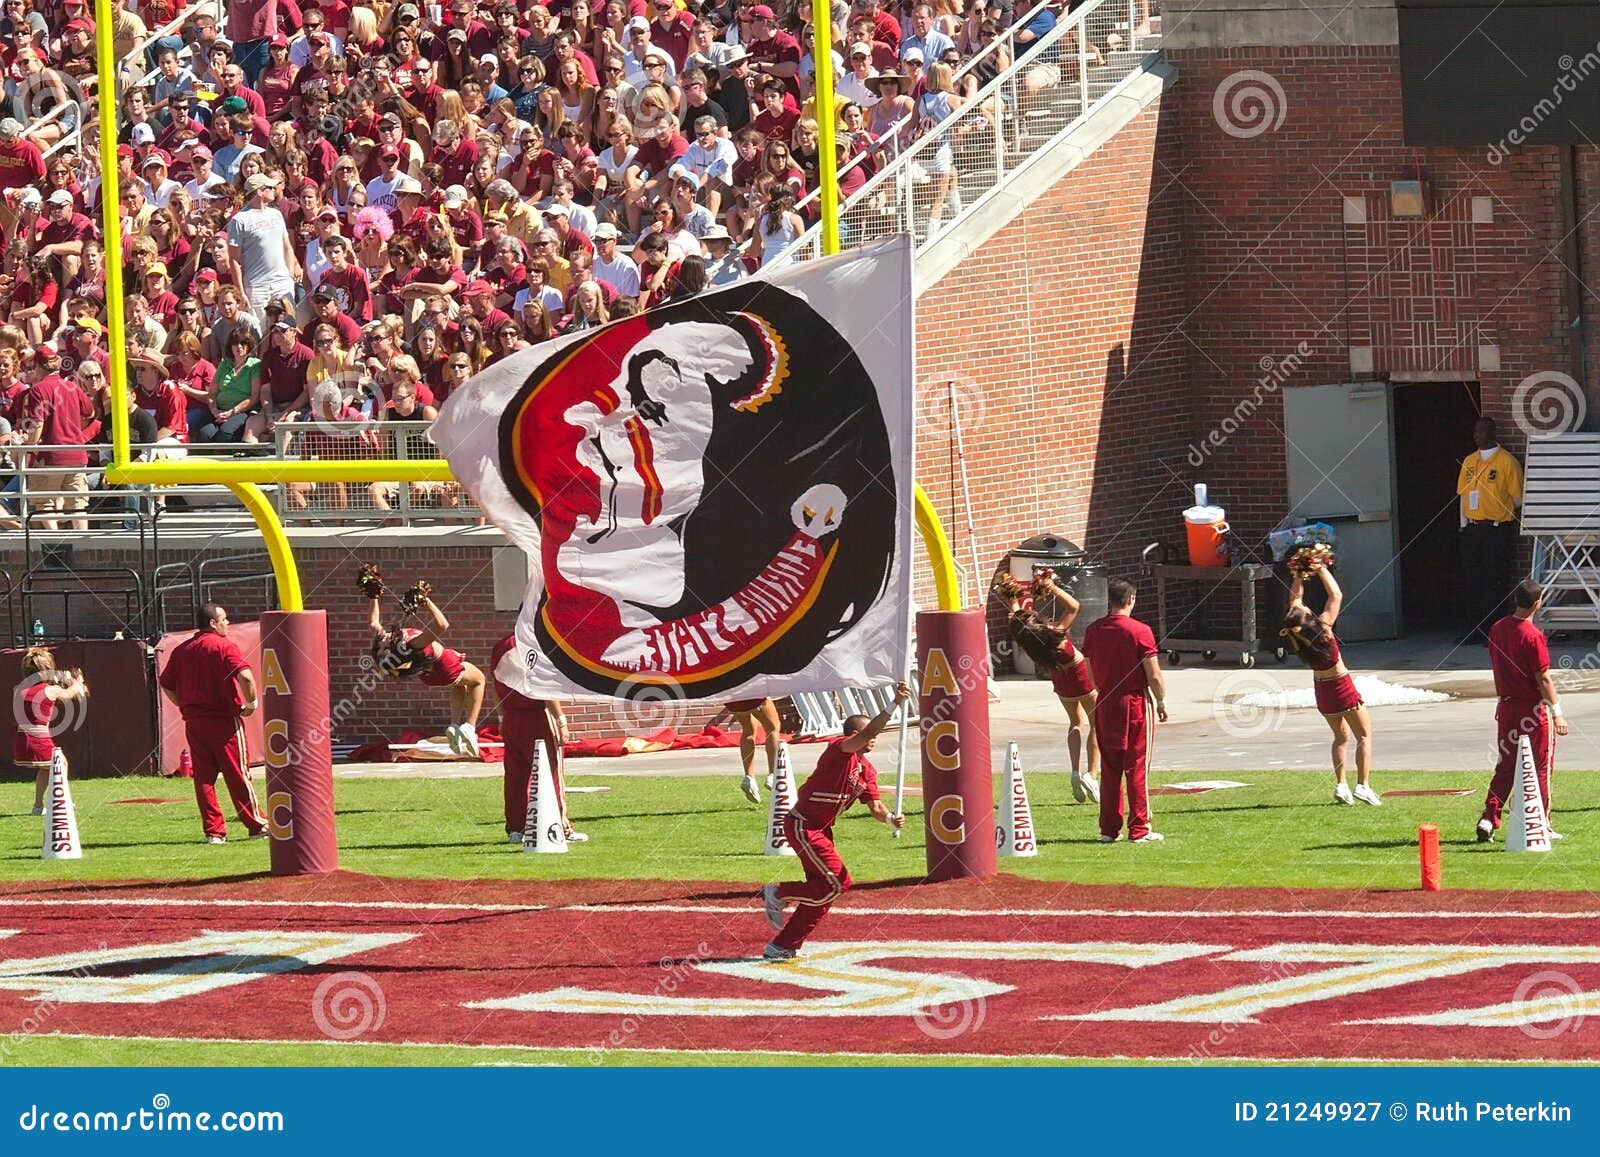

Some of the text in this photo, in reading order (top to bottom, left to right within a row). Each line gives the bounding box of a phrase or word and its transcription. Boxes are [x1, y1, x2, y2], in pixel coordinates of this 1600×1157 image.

[921, 647, 966, 845] ACC
[52, 755, 72, 852] SEMINOLES
[524, 807, 538, 848] STATE
[1521, 746, 1546, 848] FLORIDA STATE
